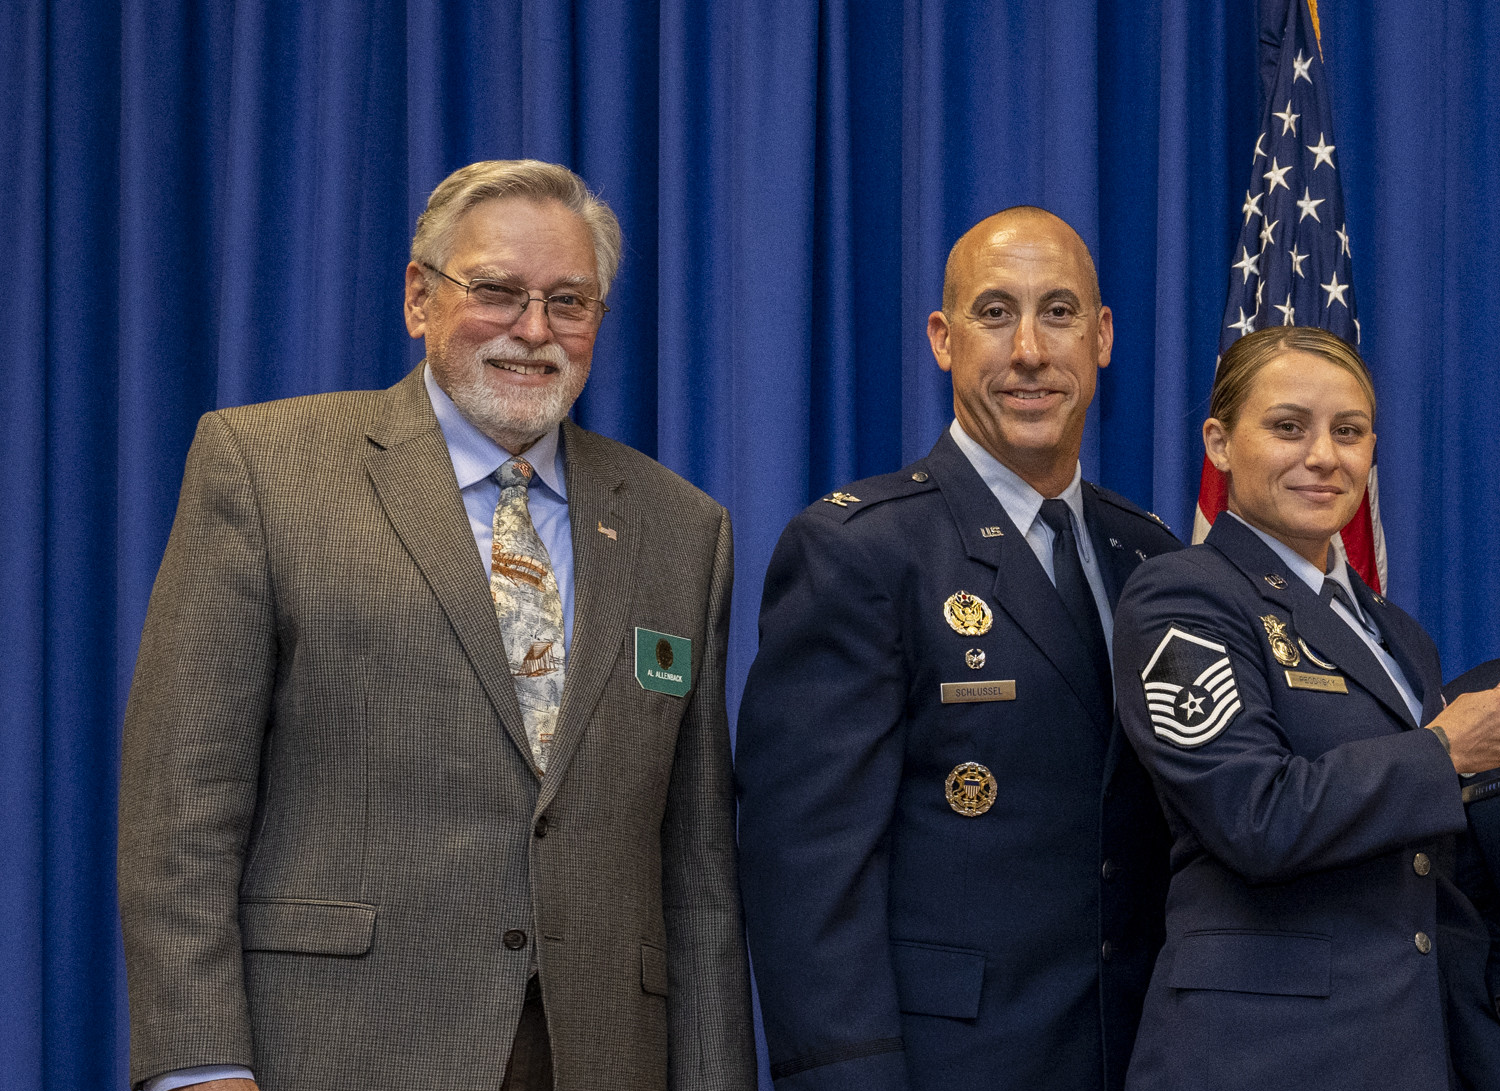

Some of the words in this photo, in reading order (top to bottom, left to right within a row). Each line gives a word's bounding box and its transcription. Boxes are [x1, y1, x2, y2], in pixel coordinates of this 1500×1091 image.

[647, 669, 655, 677] AL
[655, 671, 683, 683] ALLENBACK
[955, 687, 1003, 698] SCHLUSSEL
